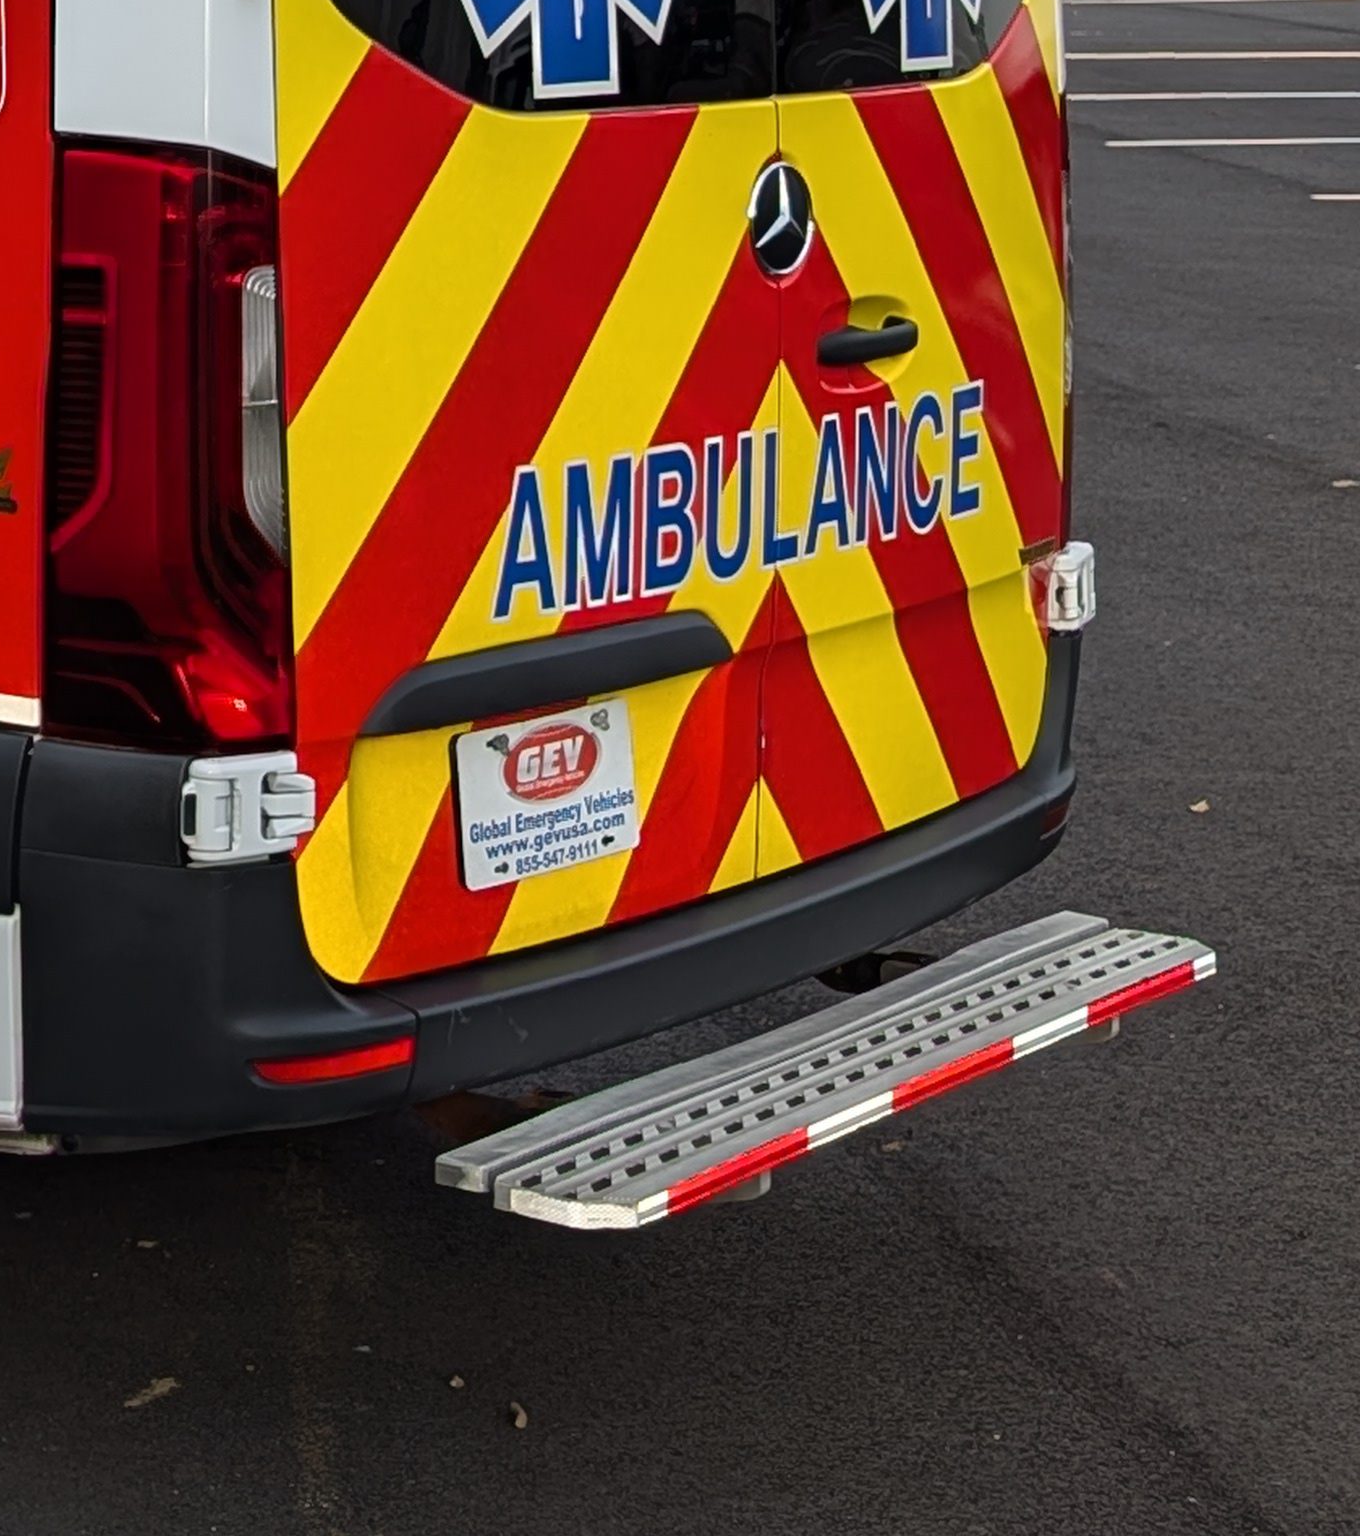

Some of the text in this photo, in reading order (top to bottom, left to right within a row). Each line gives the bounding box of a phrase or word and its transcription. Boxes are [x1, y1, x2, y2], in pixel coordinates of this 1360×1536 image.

[491, 378, 985, 622] AMBULANCE
[516, 734, 585, 784] GEV
[469, 787, 634, 843] Global Emergency Vehicles
[485, 812, 625, 859] www.gevusa.com
[515, 838, 598, 875] 855-547-9111
